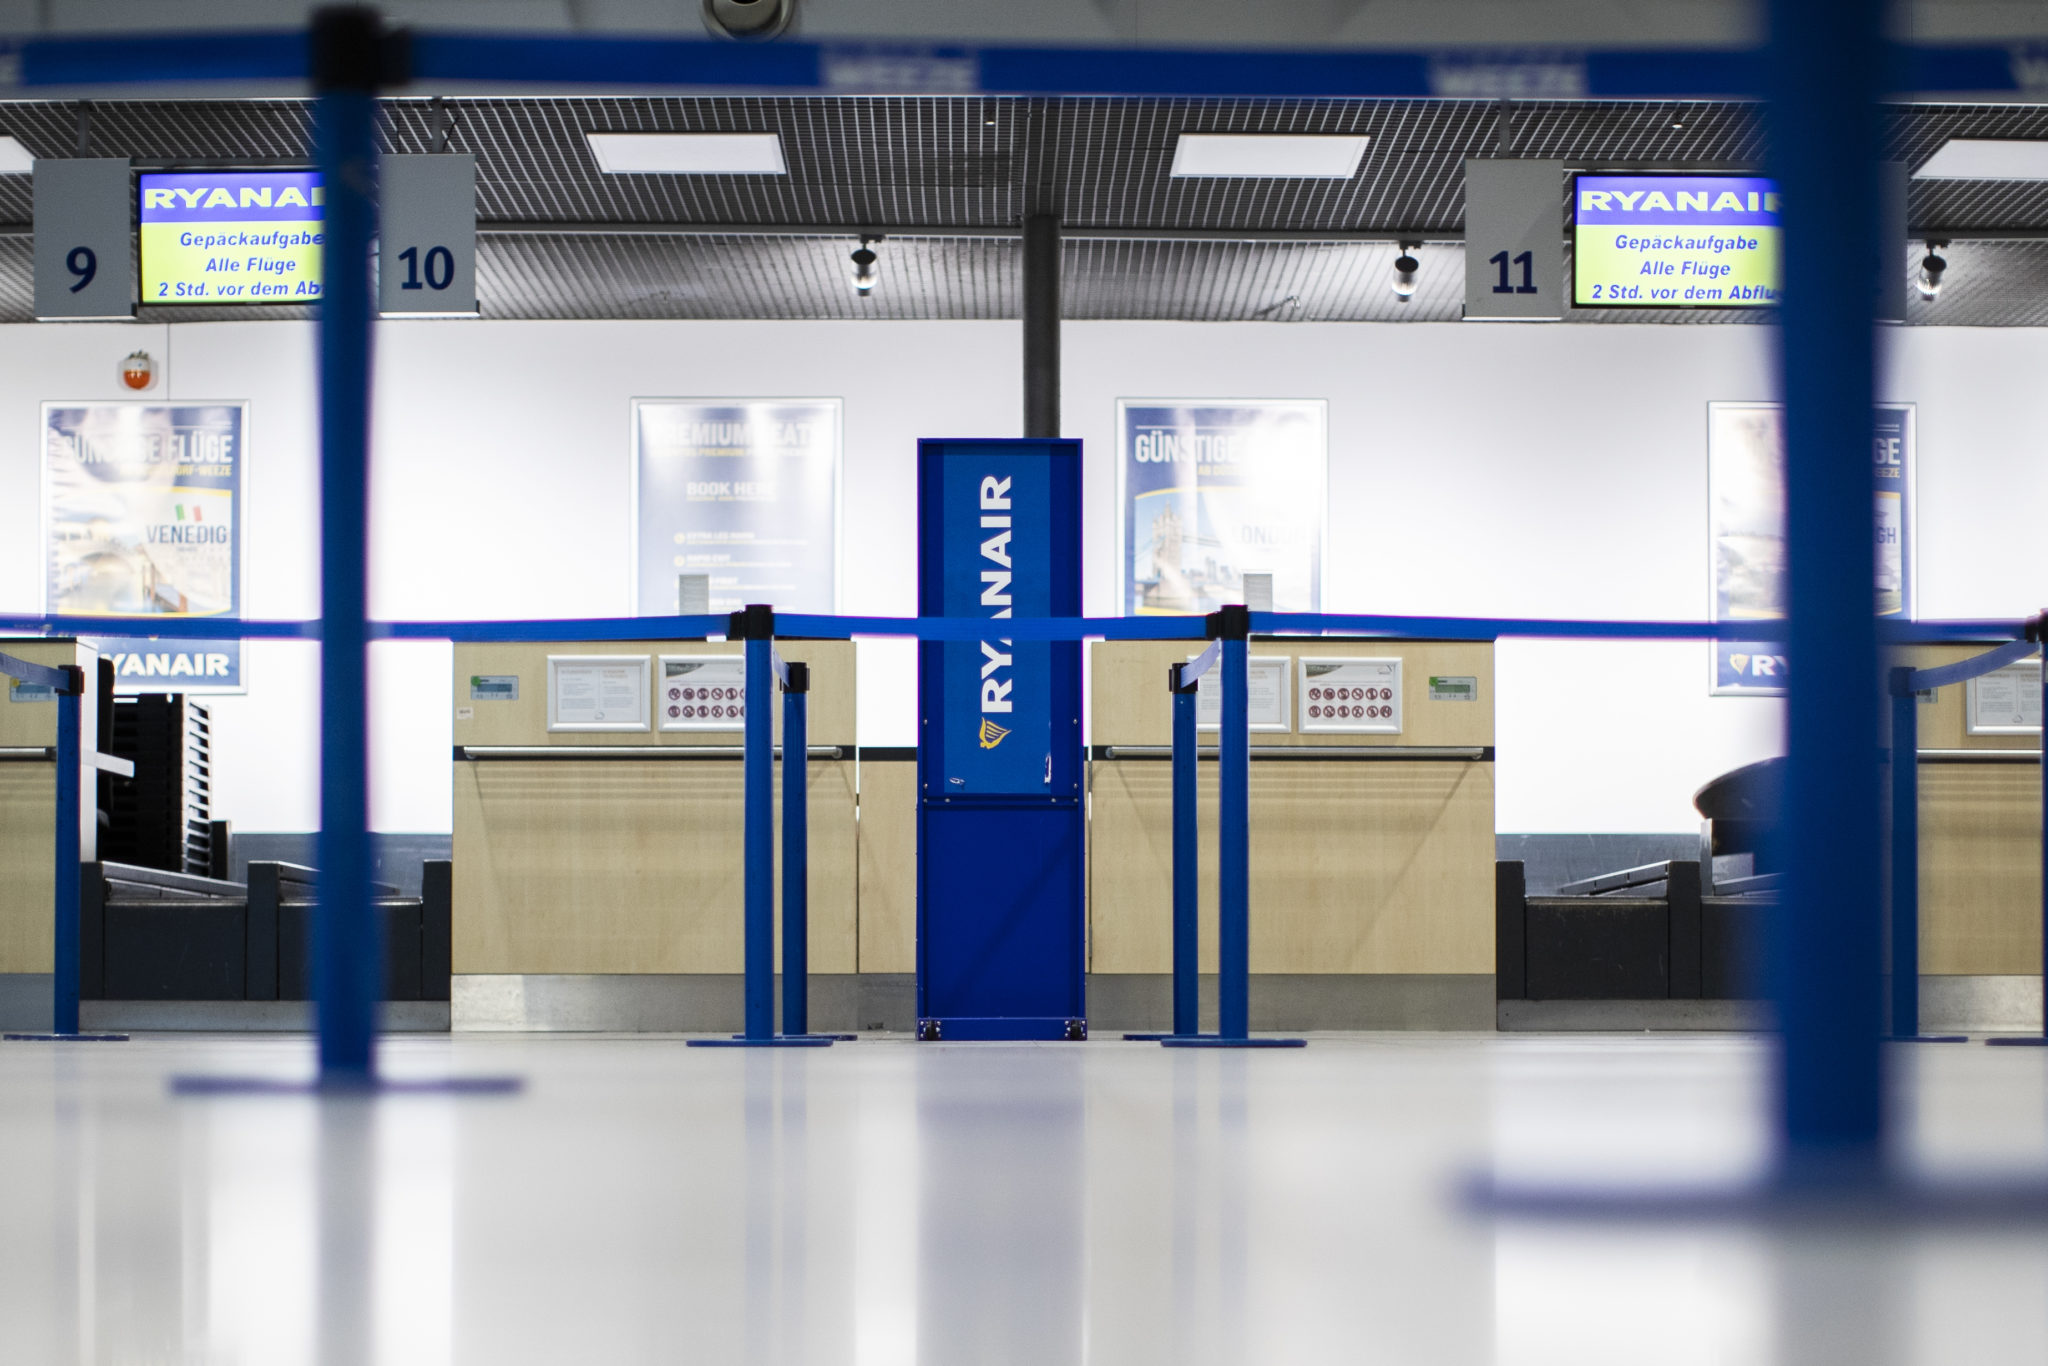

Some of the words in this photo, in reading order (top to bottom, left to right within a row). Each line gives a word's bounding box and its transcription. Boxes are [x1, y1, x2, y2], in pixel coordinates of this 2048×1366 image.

[145, 187, 325, 209] RYANAI
[180, 231, 325, 249] Gepäckaufgabe
[1615, 234, 1758, 253] Gepäckaufgabe
[65, 246, 97, 291] 9
[205, 257, 240, 272] Alle
[247, 256, 296, 276] Flüge
[398, 245, 455, 289] 10
[1489, 250, 1538, 294] 11
[1640, 260, 1675, 276] Alle
[1681, 259, 1731, 279] Flüge
[158, 282, 168, 296] 2
[175, 281, 209, 296] Std.
[217, 284, 244, 296] vor
[250, 281, 288, 296] dem
[1592, 284, 1602, 300] 2
[1608, 284, 1643, 300] Std.
[1651, 287, 1678, 300] vor
[1684, 284, 1722, 300] dem
[1729, 284, 1780, 300] Abflu
[167, 430, 233, 464] FLÜGE
[686, 481, 731, 496] BOOK
[733, 481, 777, 496] HERE
[146, 524, 228, 544] VENEDIG
[102, 652, 230, 677] YANAIR
